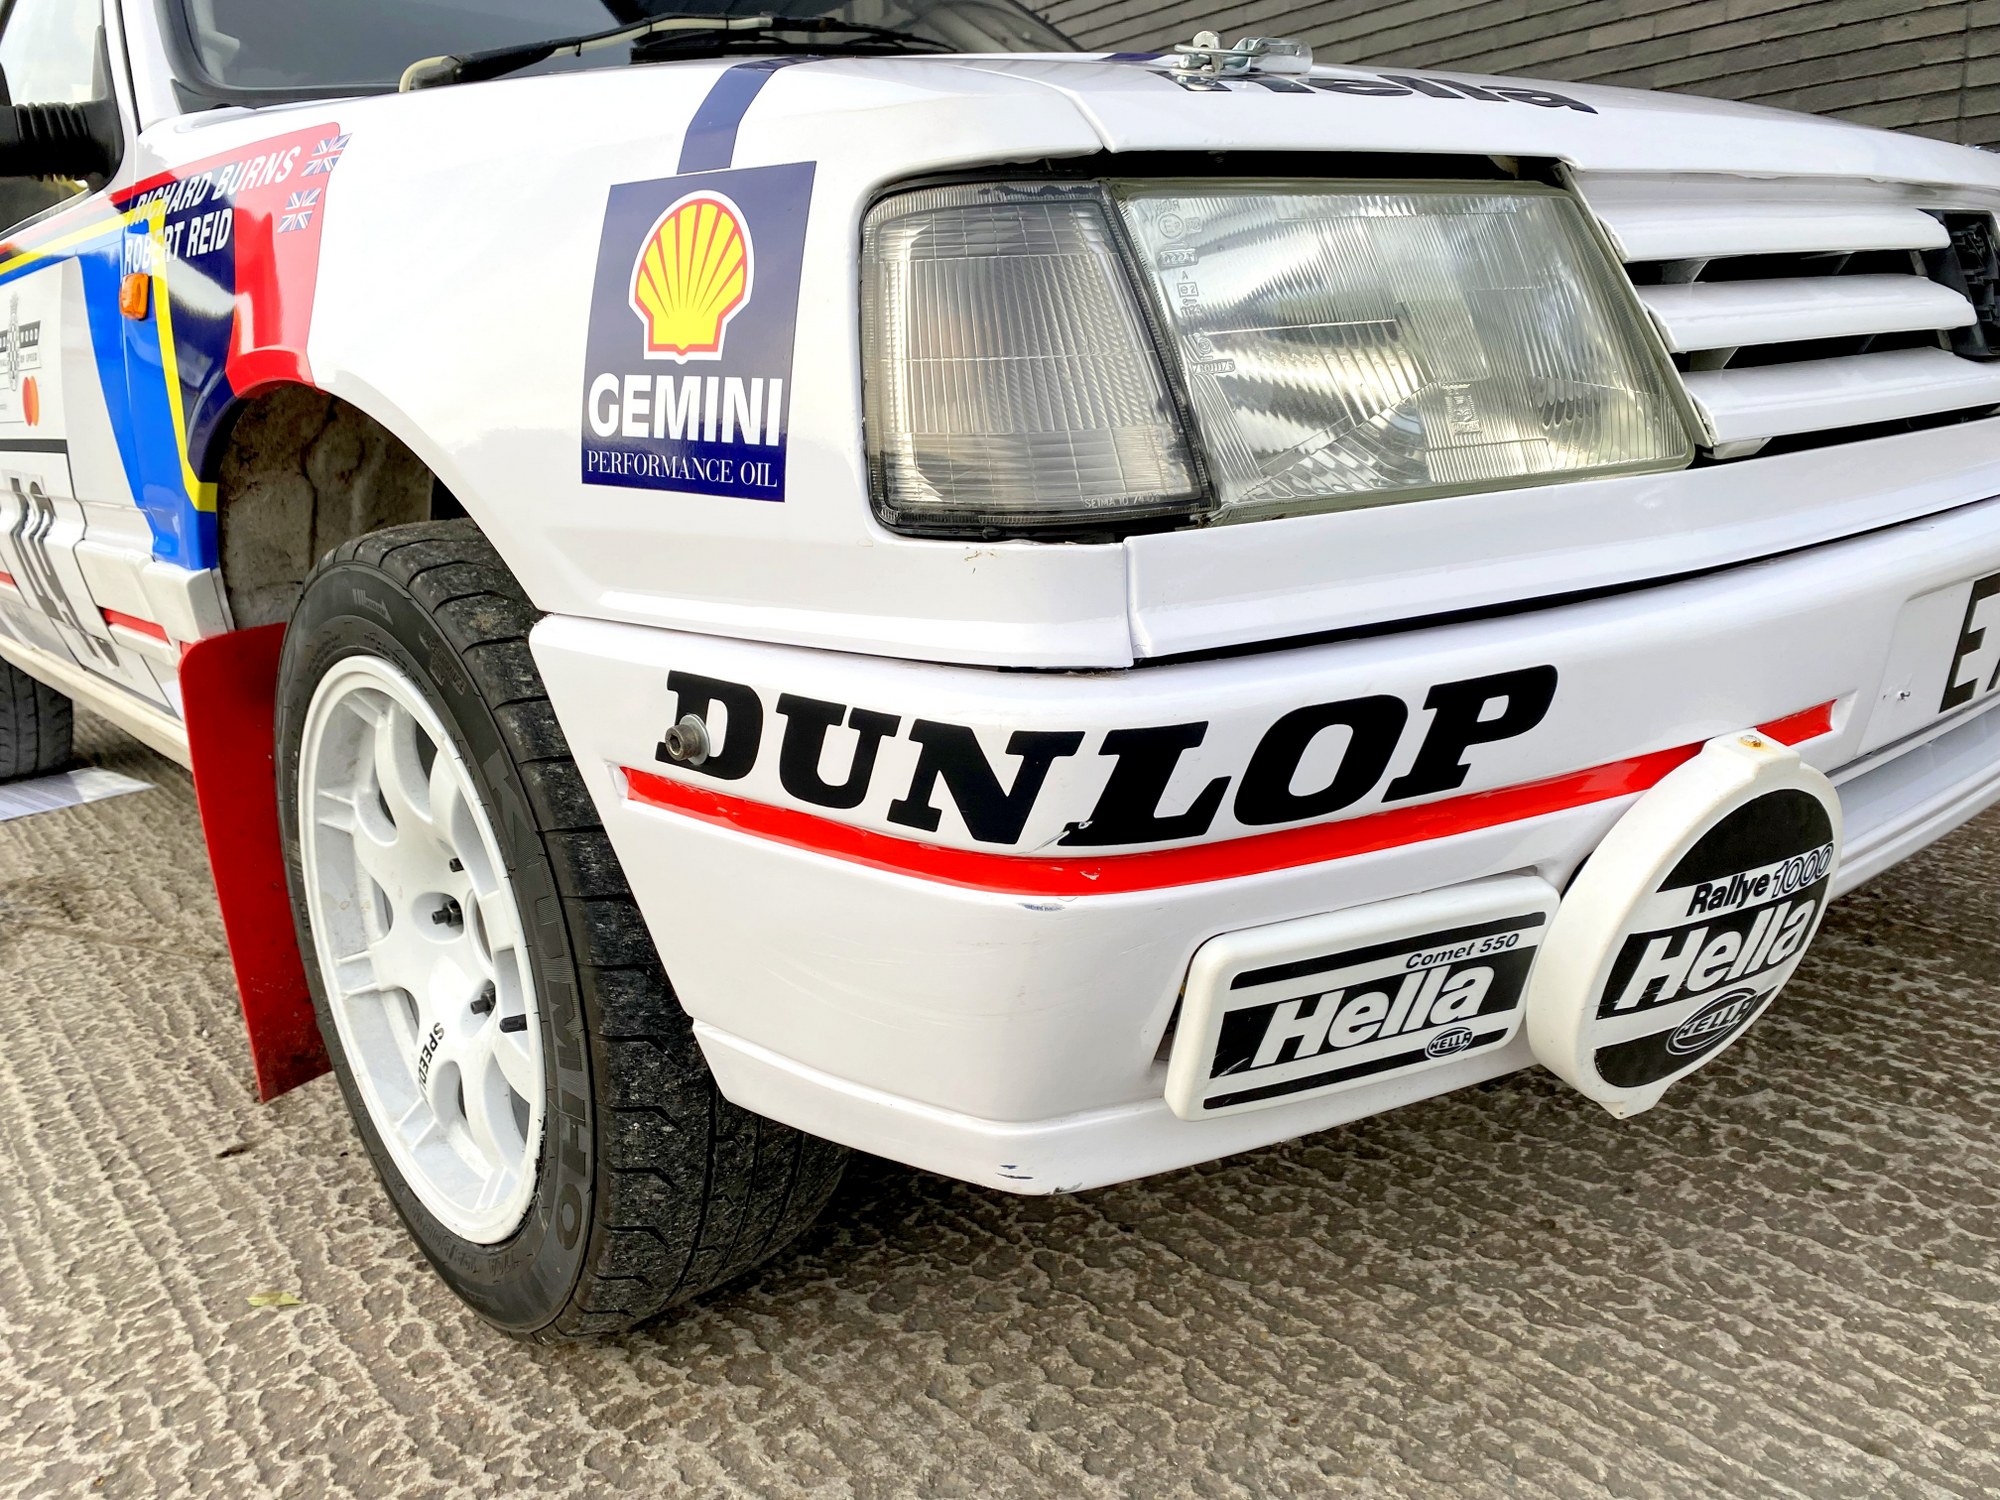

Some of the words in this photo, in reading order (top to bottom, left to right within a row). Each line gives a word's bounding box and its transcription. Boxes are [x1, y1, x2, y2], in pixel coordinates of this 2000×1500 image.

[211, 146, 301, 200] BURNS
[186, 208, 233, 258] REID
[588, 372, 783, 447] GEMINI
[587, 450, 734, 483] PERFORMANCE
[740, 461, 778, 488] OIL
[1938, 572, 2000, 714] E
[655, 664, 1558, 847] DUNLOP
[1686, 870, 1770, 917] Rallye
[1772, 842, 1835, 898] 1000
[1405, 942, 1477, 970] Comet
[1479, 933, 1521, 954] 550
[1613, 899, 1817, 1011] Hella
[1250, 964, 1495, 1069] Hella
[1429, 1031, 1473, 1051] HELLA
